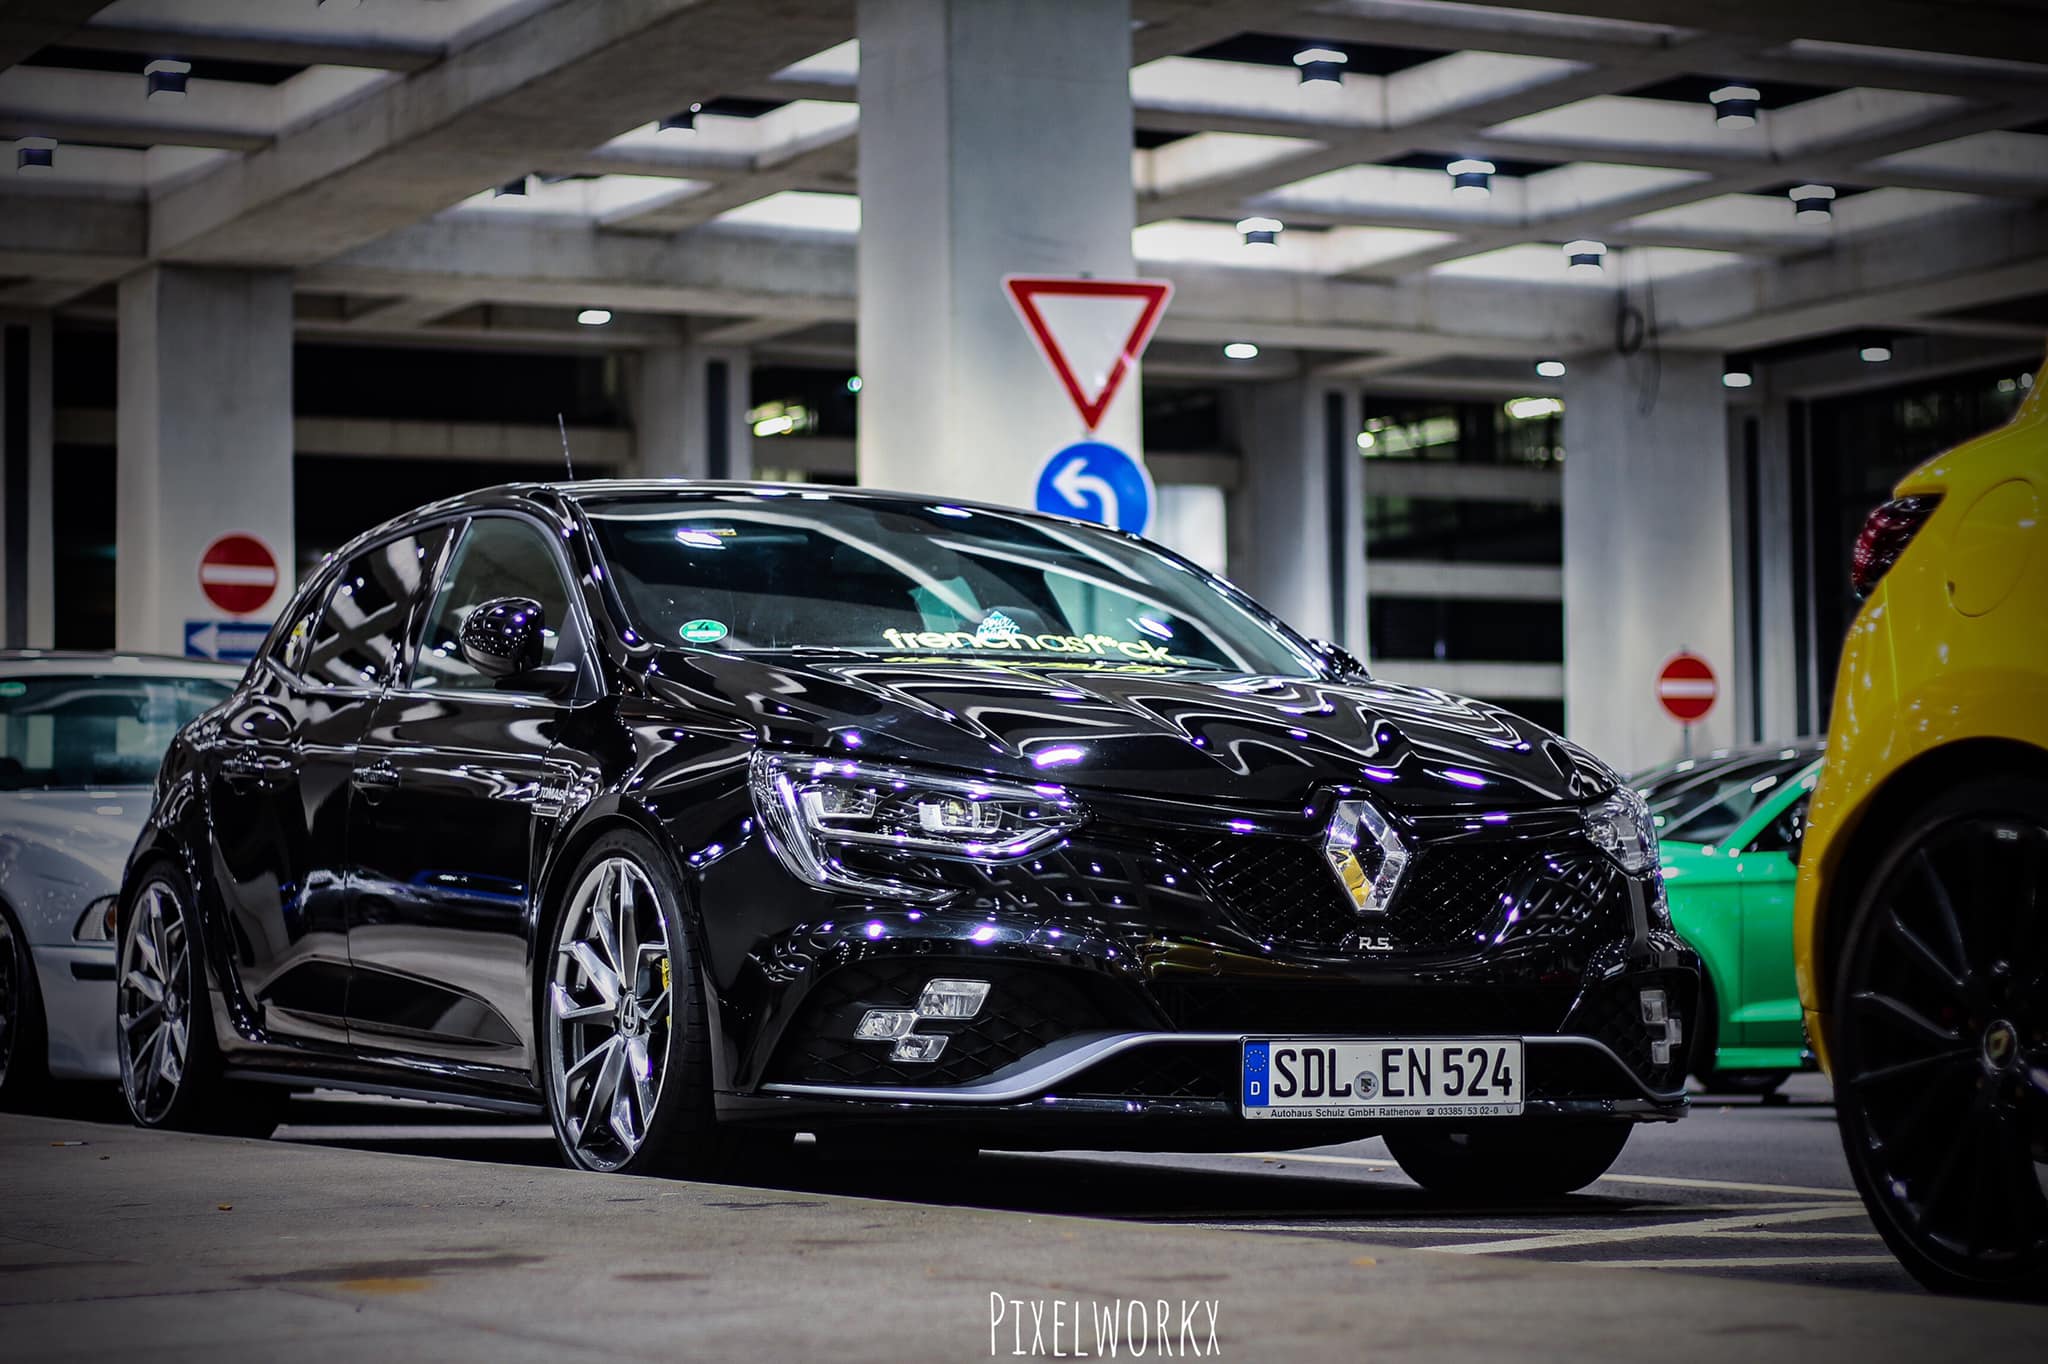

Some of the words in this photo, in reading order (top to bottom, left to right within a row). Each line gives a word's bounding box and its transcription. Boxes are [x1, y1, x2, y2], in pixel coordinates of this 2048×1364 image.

[1274, 1048, 1352, 1098] SDL
[1381, 1047, 1431, 1097] EN
[1443, 1047, 1513, 1097] 524
[1250, 1081, 1261, 1096] D
[1270, 1108, 1312, 1118] Autohaus
[1315, 1108, 1345, 1117] Schulz
[1348, 1107, 1376, 1117] GmbH
[1379, 1107, 1421, 1116] Rathenow
